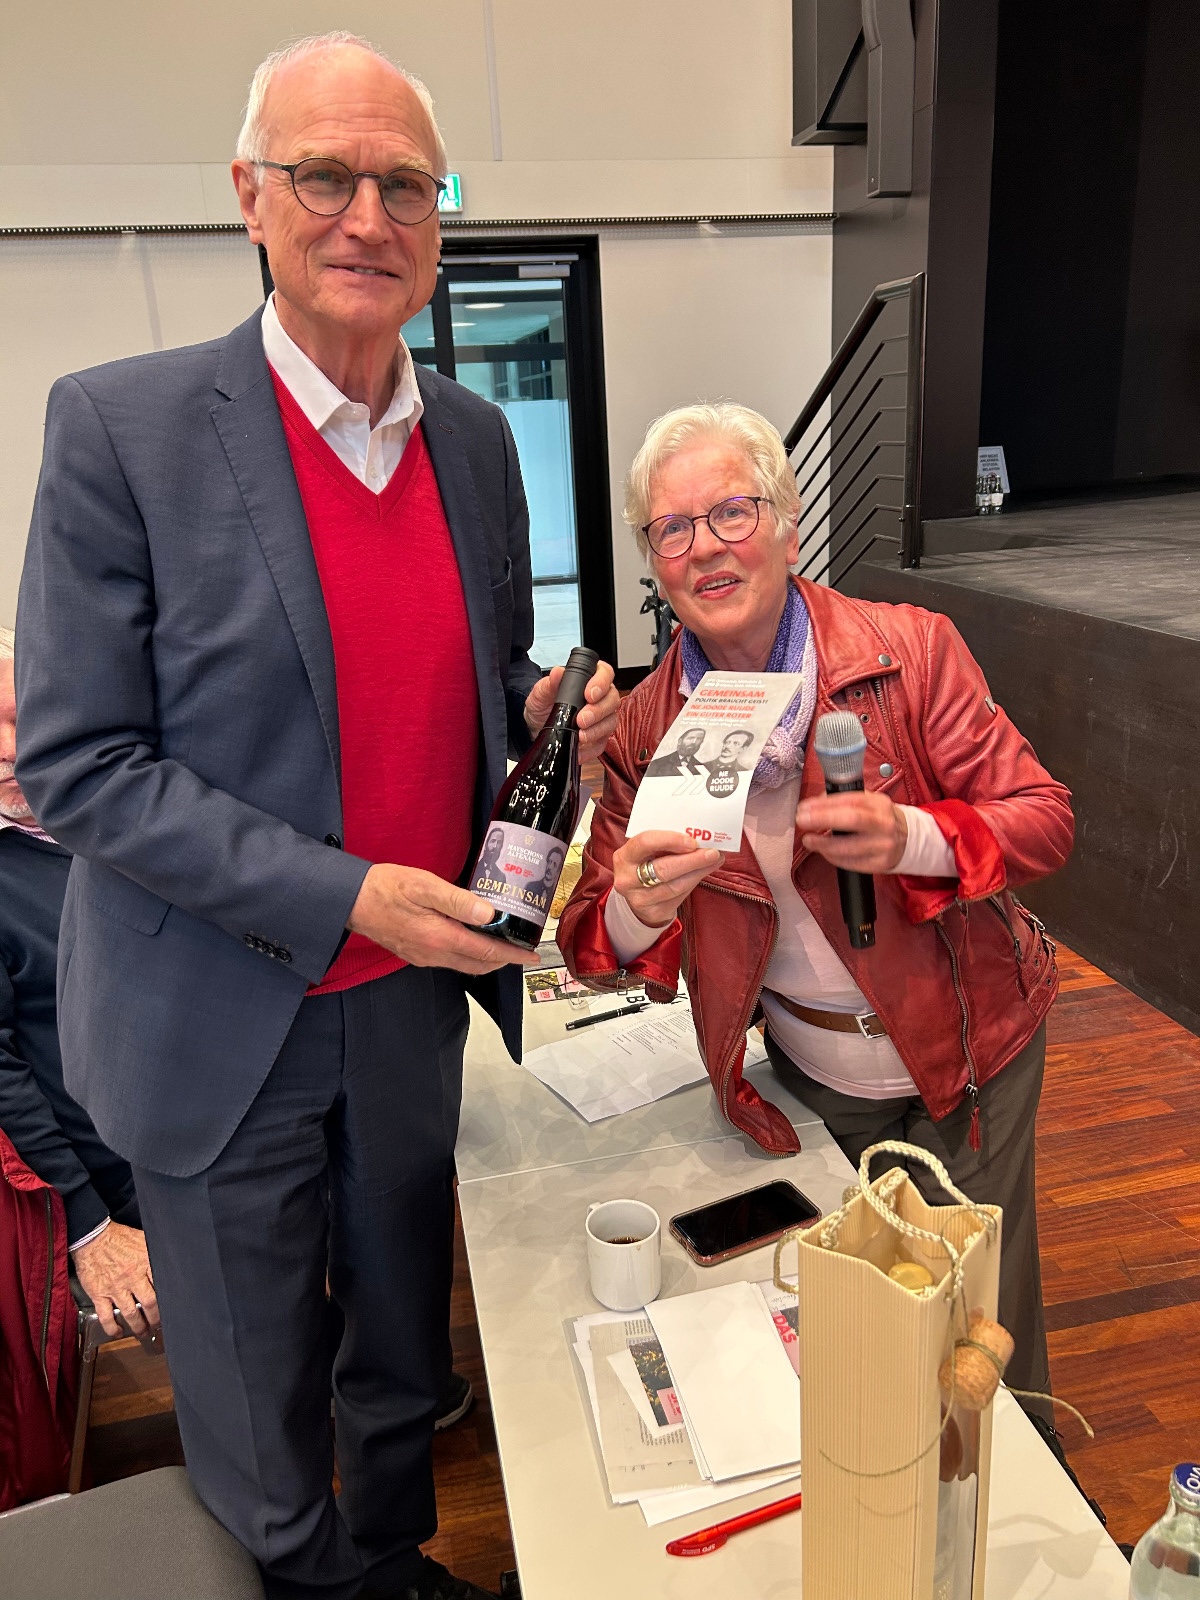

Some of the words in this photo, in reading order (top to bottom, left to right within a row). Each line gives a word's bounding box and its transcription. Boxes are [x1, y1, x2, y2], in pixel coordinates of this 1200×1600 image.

[699, 689, 765, 698] GEMEINSAM
[718, 770, 729, 778] NE
[710, 777, 734, 785] JOODE
[709, 784, 734, 792] RUUDE
[685, 827, 712, 841] SPD
[507, 843, 544, 860] MAYSCHOSS
[503, 863, 523, 876] SPD
[476, 877, 547, 909] GEMEINSAM
[773, 1314, 798, 1344] DAS
[702, 1543, 716, 1553] SPD
